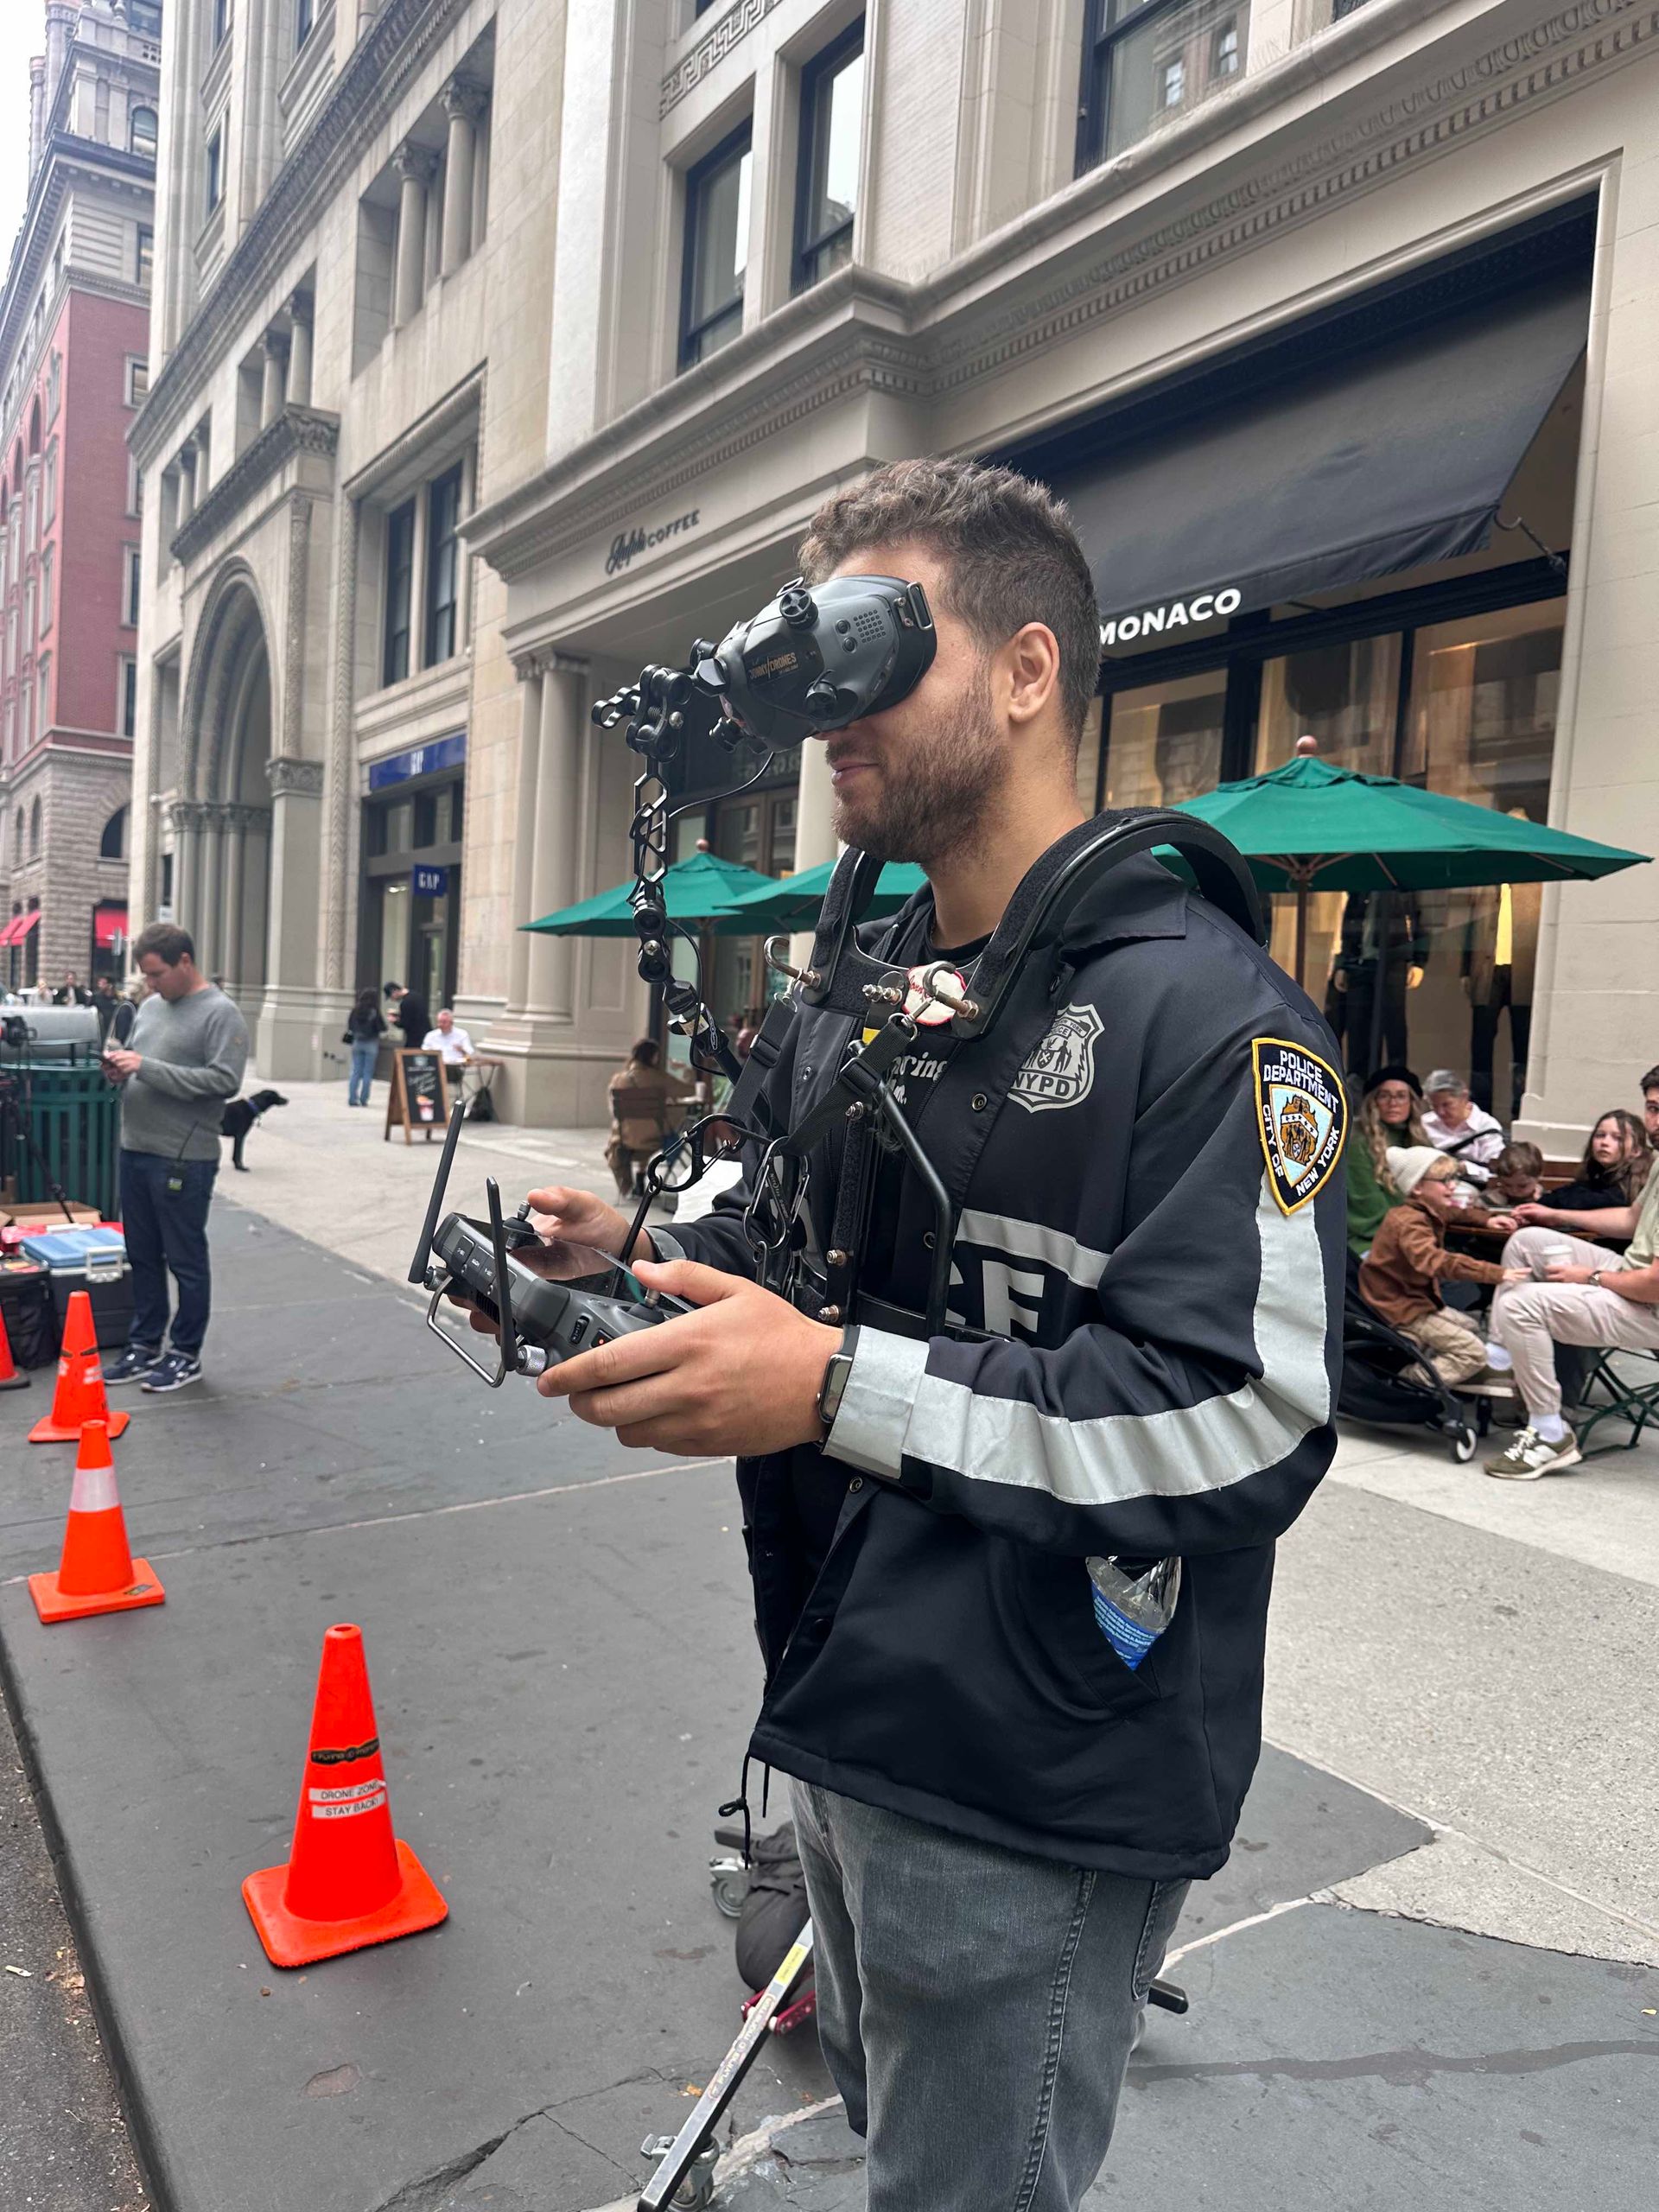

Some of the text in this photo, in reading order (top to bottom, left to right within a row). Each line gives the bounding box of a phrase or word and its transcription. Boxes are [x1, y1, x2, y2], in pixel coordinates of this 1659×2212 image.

[647, 508, 701, 549] COFFEE
[1099, 588, 1242, 645] MONACO
[1014, 1072, 1071, 1096] NYPD
[1280, 1050, 1323, 1084] POLICE
[1263, 1065, 1339, 1114] DEPARTMENT
[1262, 1103, 1339, 1197] CITY OF NEW YORK
[325, 1803, 351, 1817] STAY
